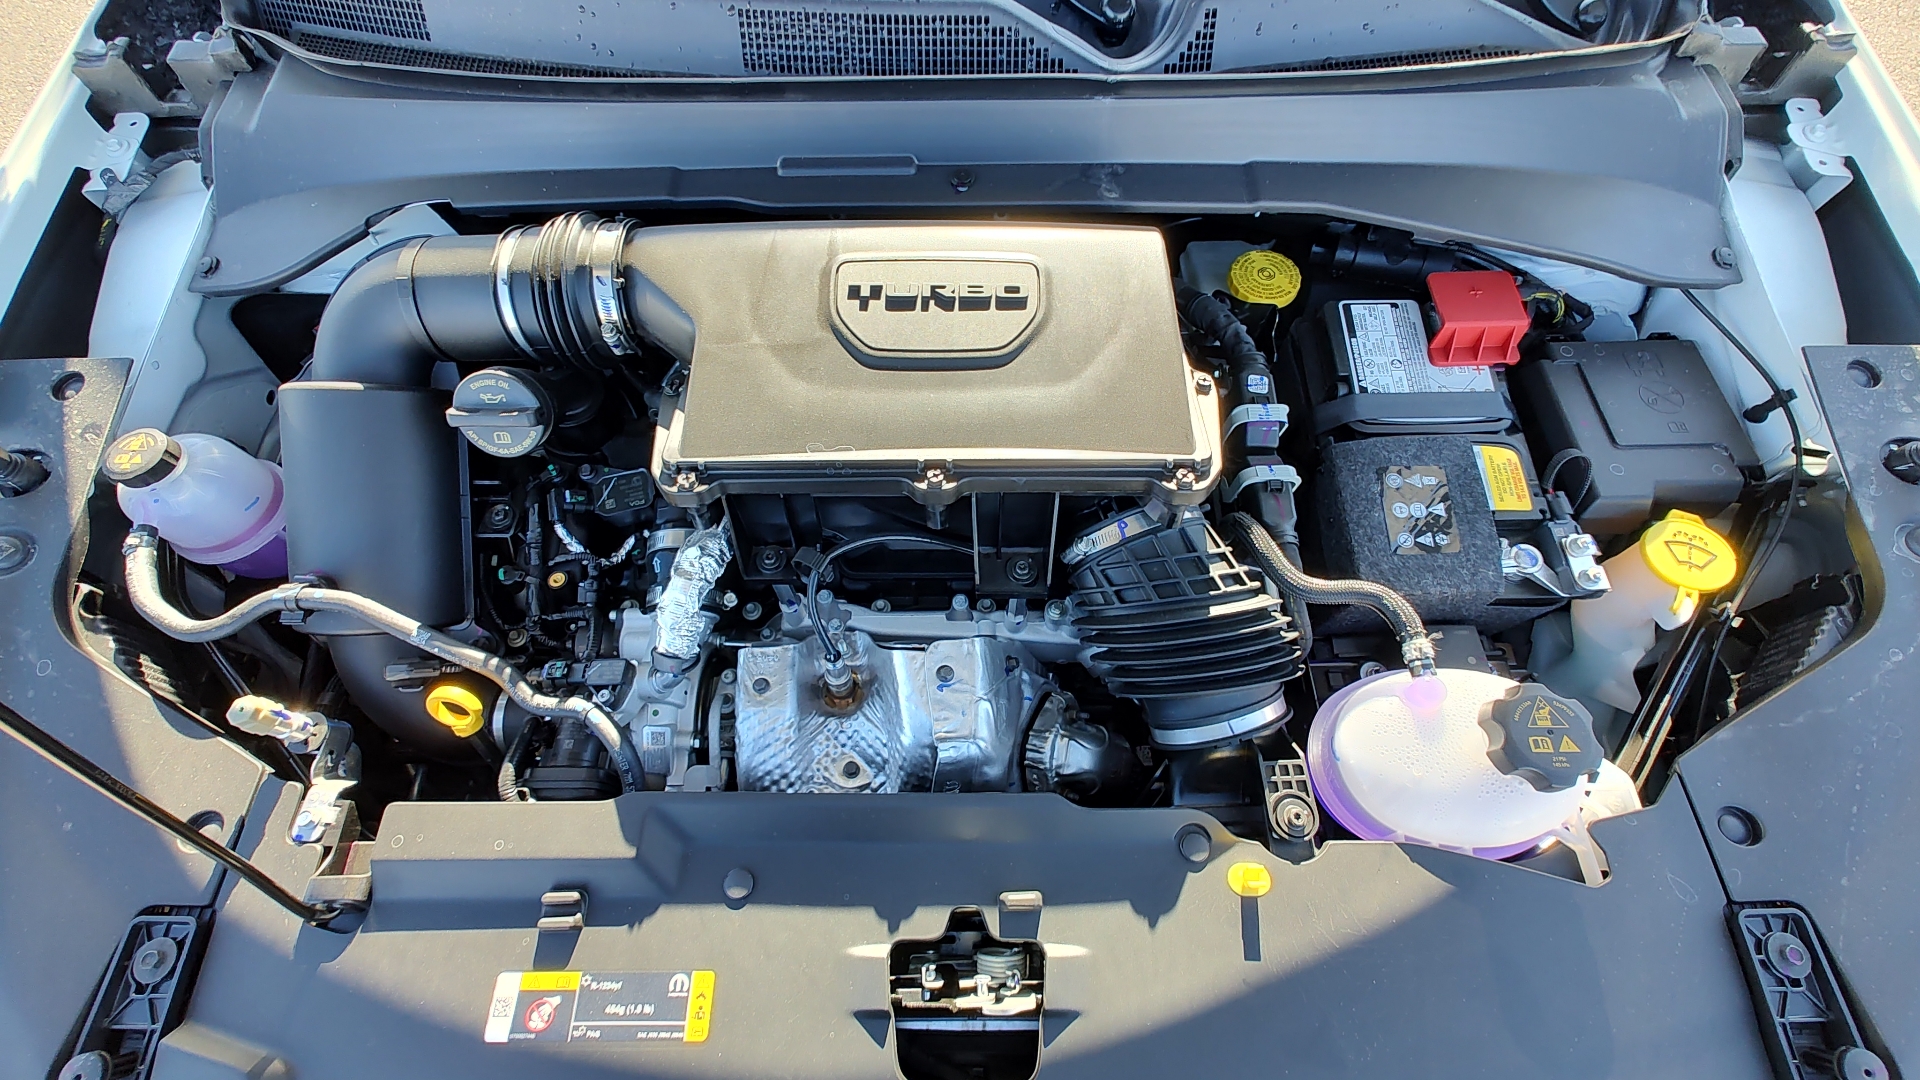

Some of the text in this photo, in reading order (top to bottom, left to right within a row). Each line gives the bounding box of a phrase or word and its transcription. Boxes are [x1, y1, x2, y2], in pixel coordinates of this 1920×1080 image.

[847, 283, 1028, 311] TURBO
[469, 379, 510, 390] ENGINE OIL
[466, 430, 478, 442] API
